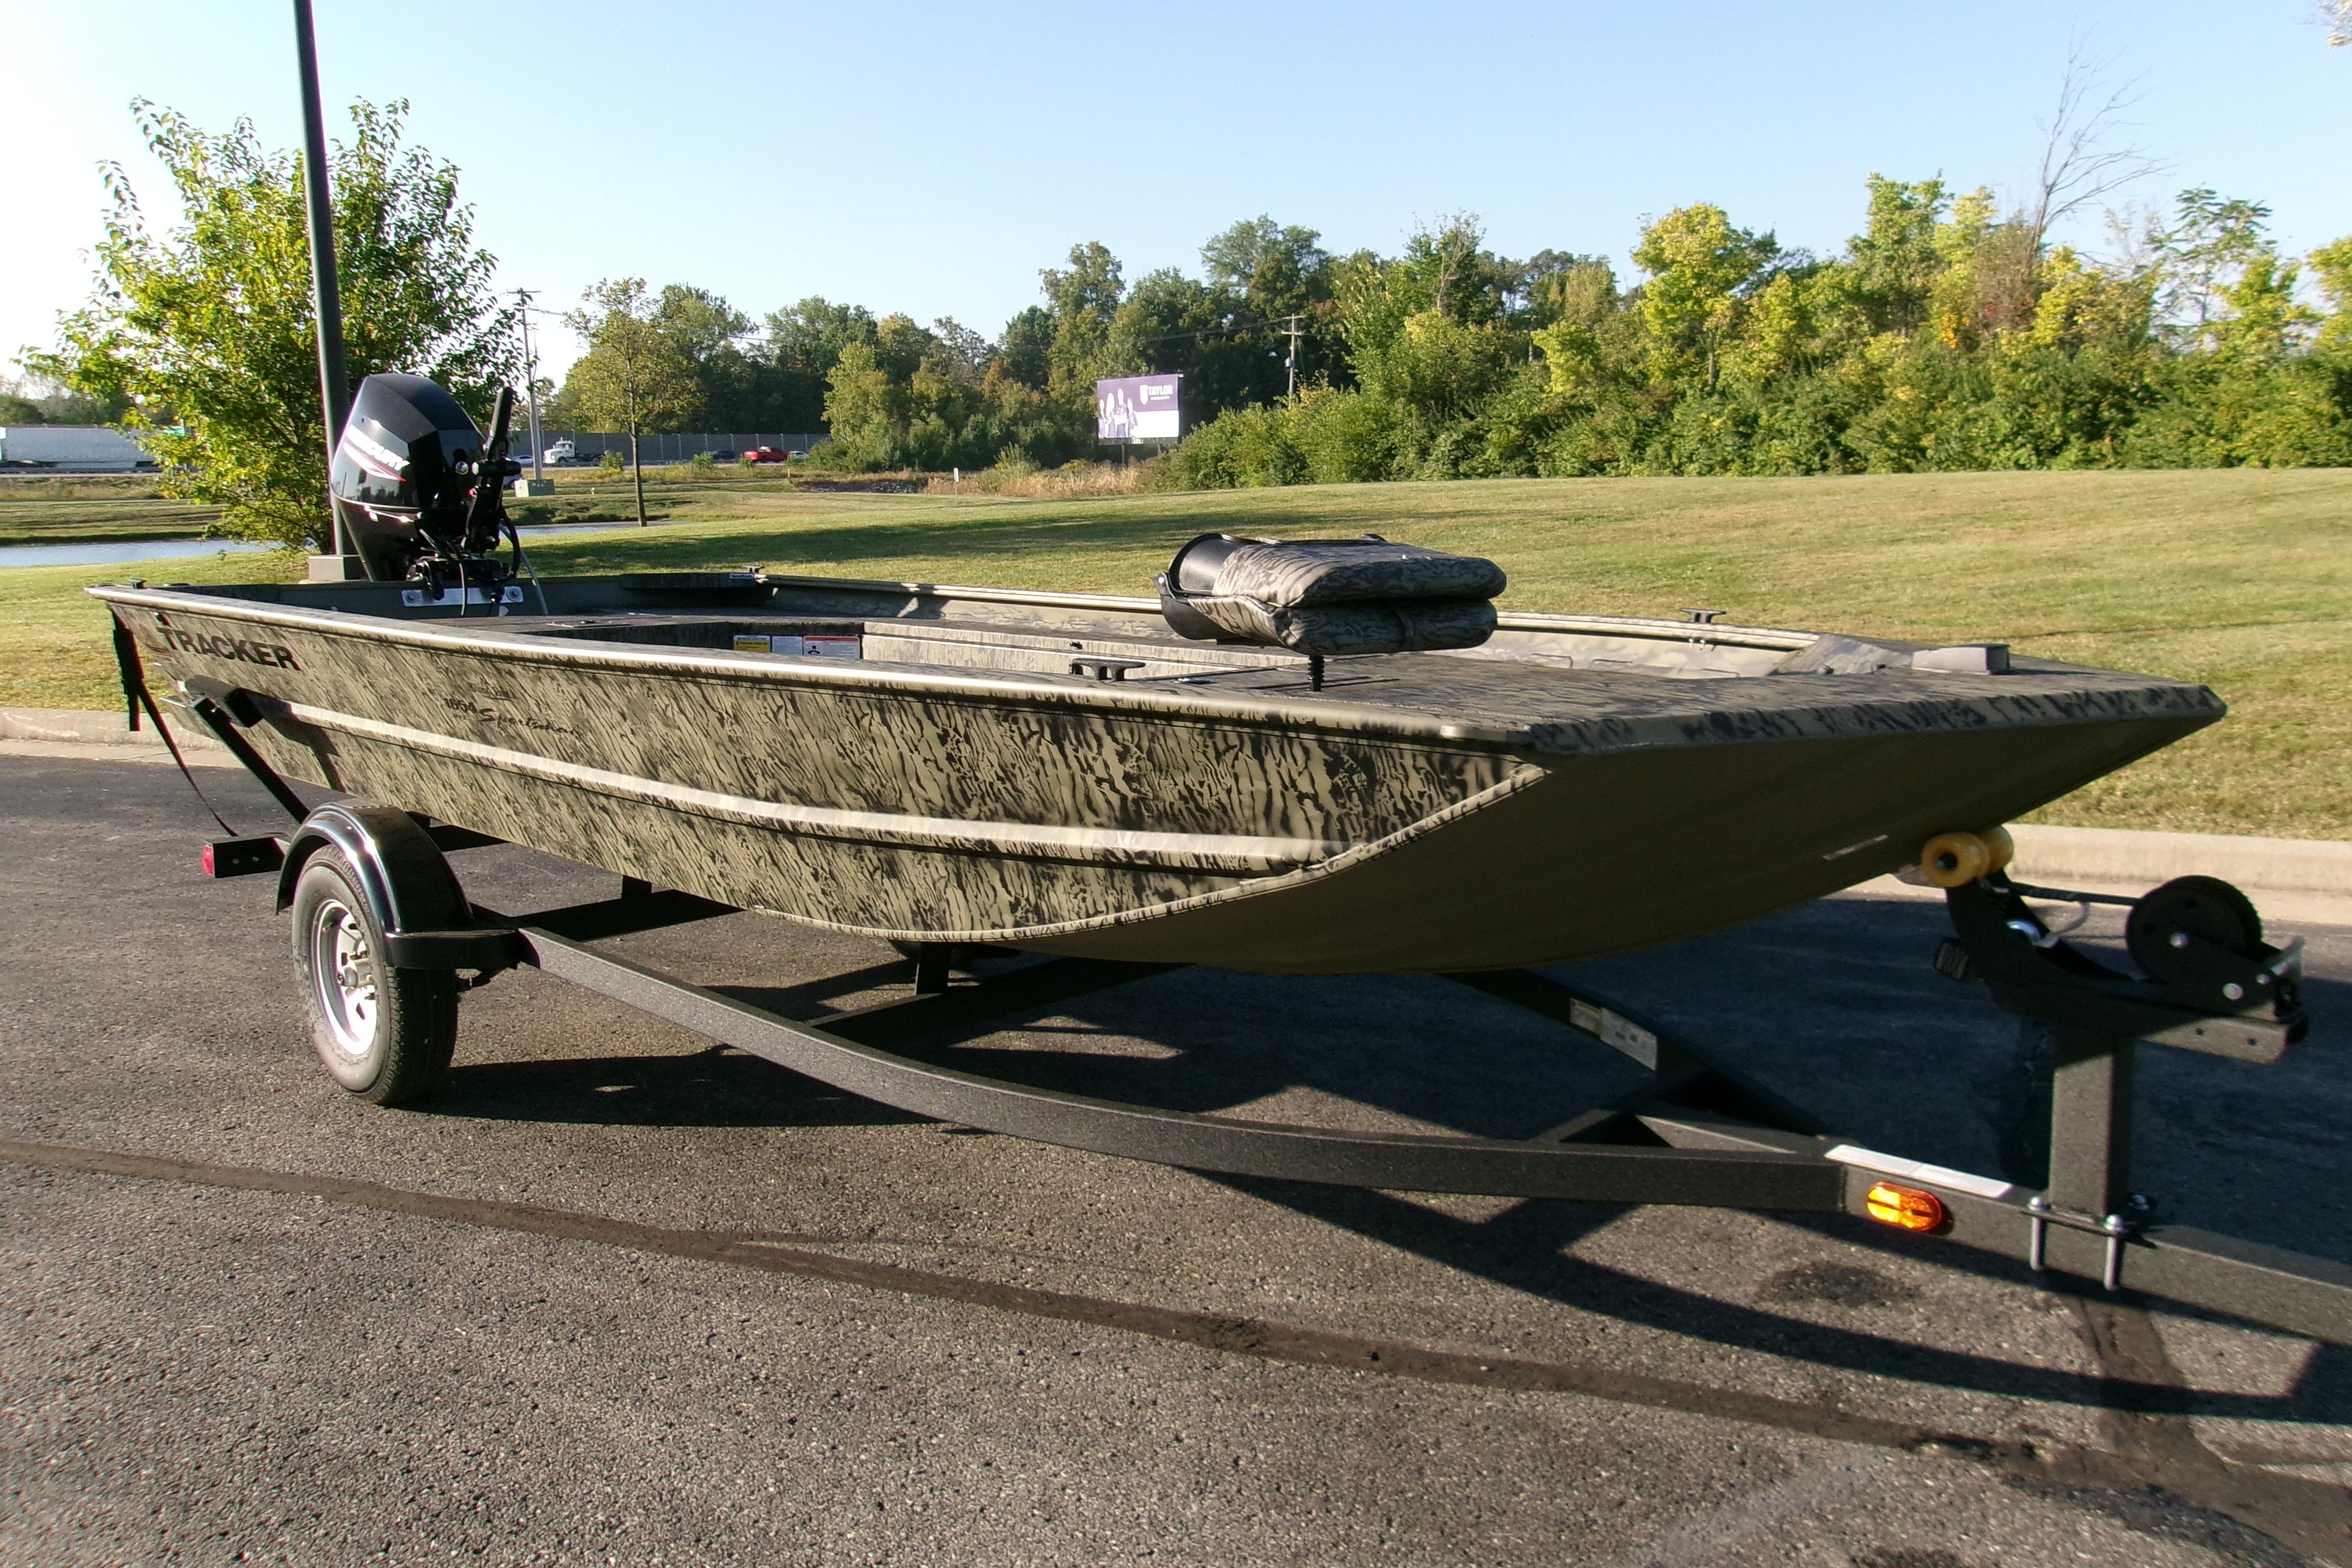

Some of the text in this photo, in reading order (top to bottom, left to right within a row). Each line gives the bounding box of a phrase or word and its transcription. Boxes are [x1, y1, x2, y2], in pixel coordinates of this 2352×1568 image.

[1148, 385, 1173, 396] TAYLOR
[346, 425, 410, 471] CURY
[158, 627, 302, 670] TRACKER
